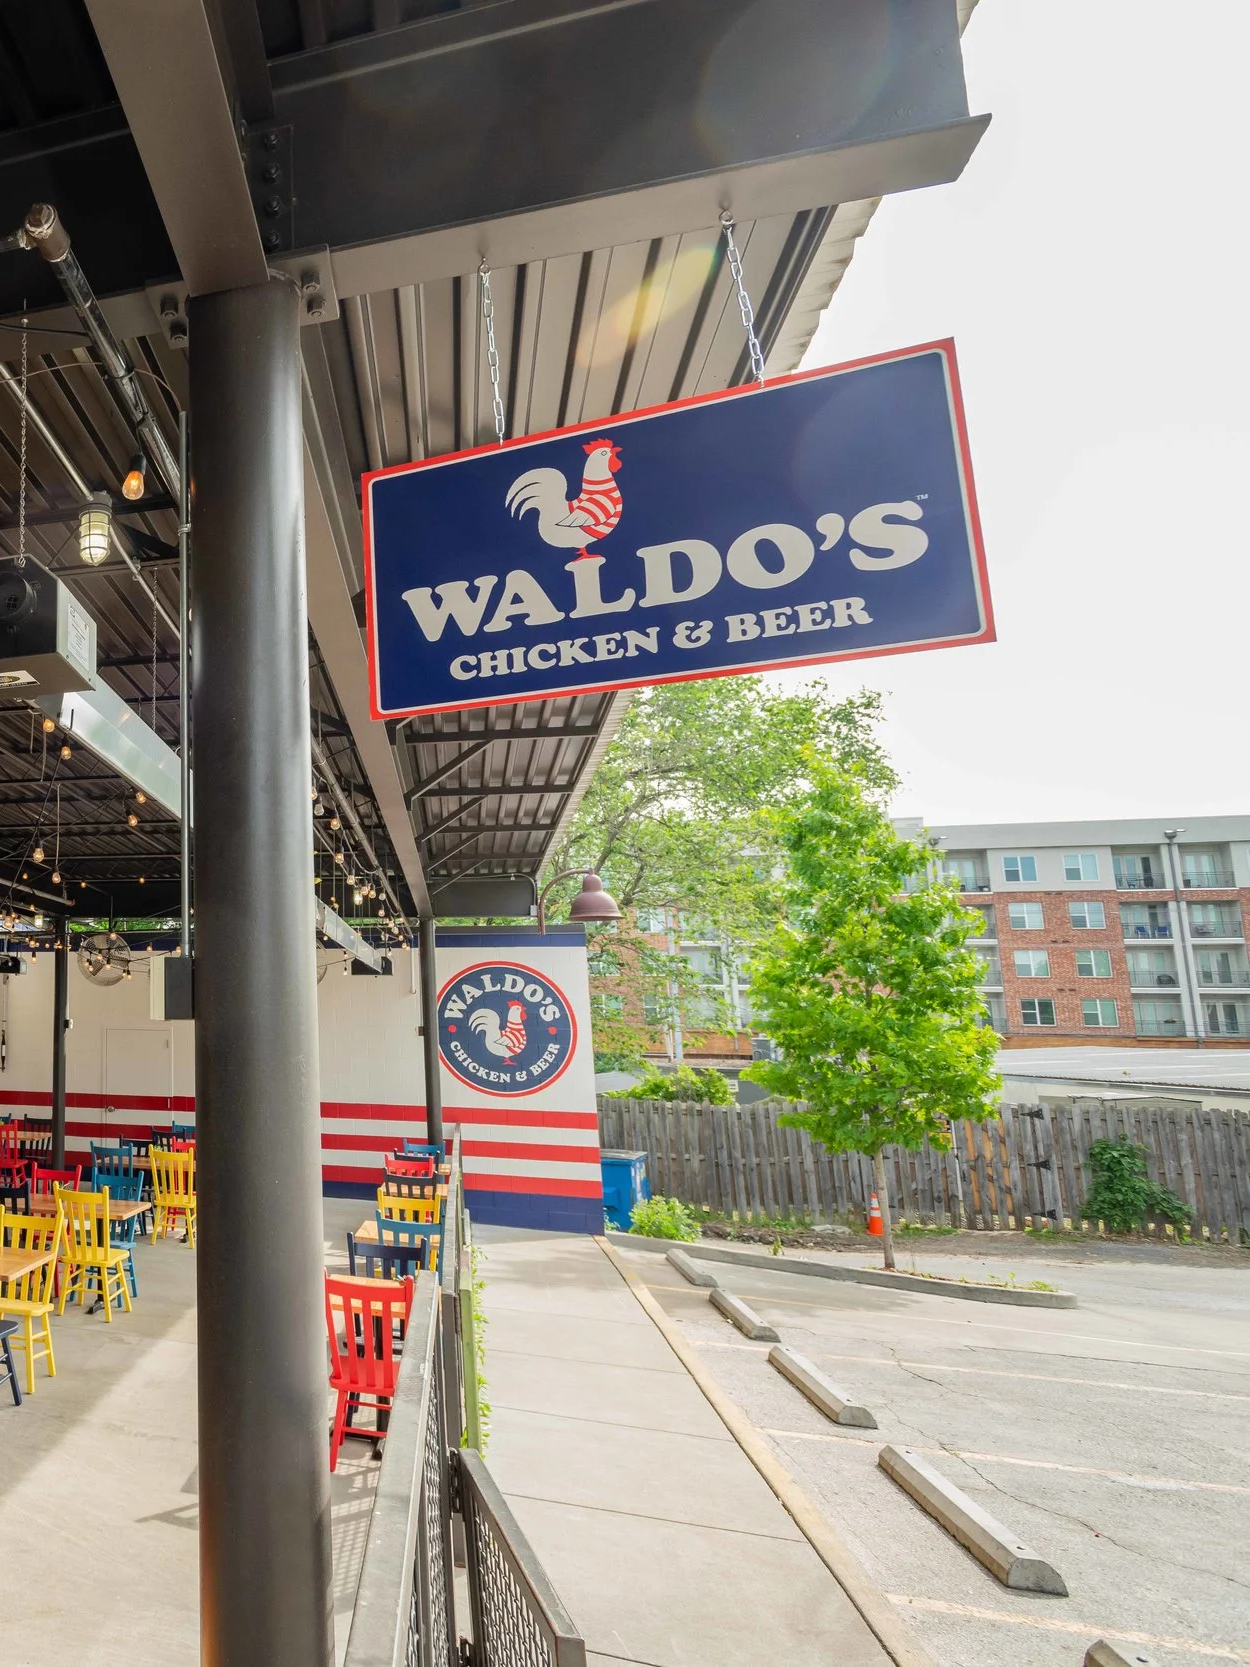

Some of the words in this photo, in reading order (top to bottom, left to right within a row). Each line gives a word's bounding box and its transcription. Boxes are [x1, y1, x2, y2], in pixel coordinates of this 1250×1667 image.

[402, 501, 929, 642] WALDO'S
[450, 627, 659, 681] CHICKEN
[672, 620, 712, 649] &
[725, 597, 873, 645] BEER
[444, 973, 561, 1022] WALDO'S
[450, 1041, 511, 1083] CHICKEN
[515, 1070, 528, 1082] &
[529, 1042, 561, 1077] BEER
